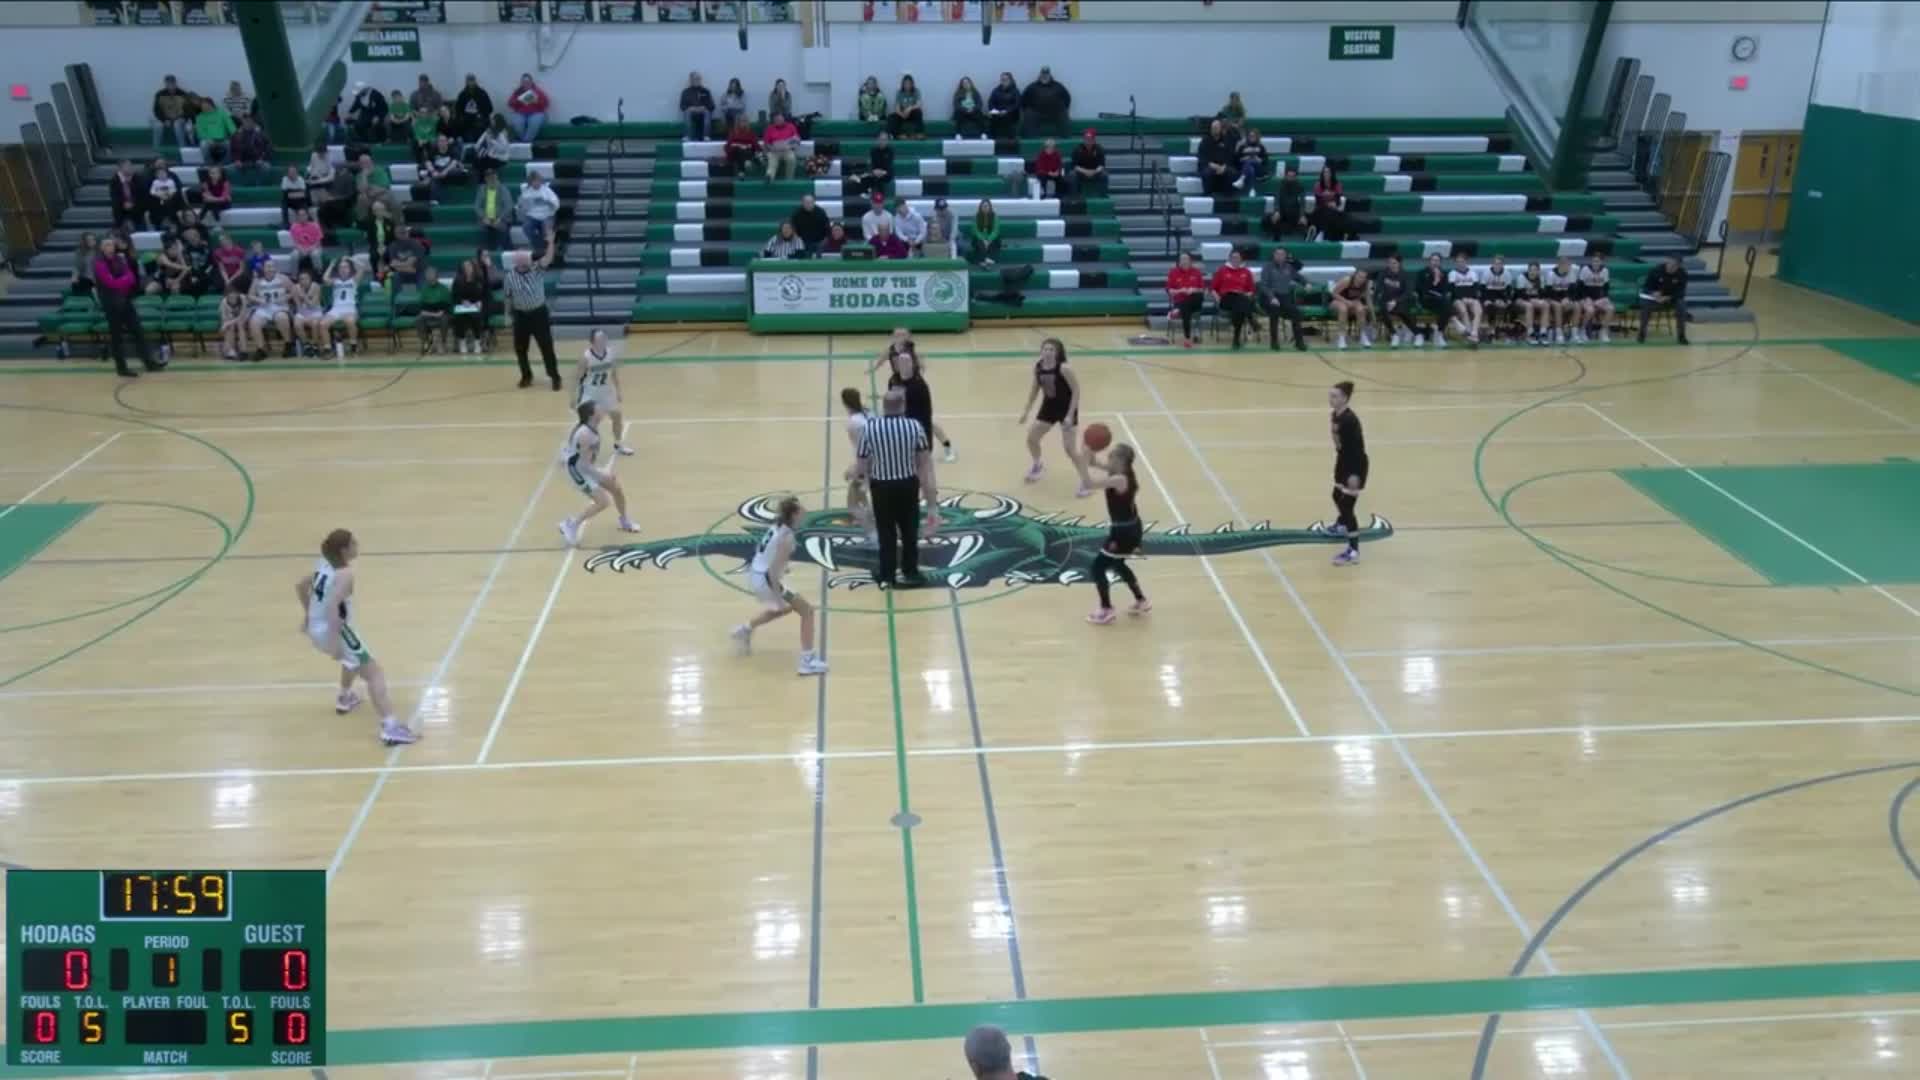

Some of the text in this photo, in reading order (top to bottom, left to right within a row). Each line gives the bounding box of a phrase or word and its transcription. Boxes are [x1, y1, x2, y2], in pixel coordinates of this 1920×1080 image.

[1344, 30, 1380, 41] VISITOR
[368, 45, 404, 56] ADULTS
[1344, 44, 1380, 54] SEATING
[832, 276, 917, 288] HOME OF THE
[829, 292, 920, 308] HODAGS
